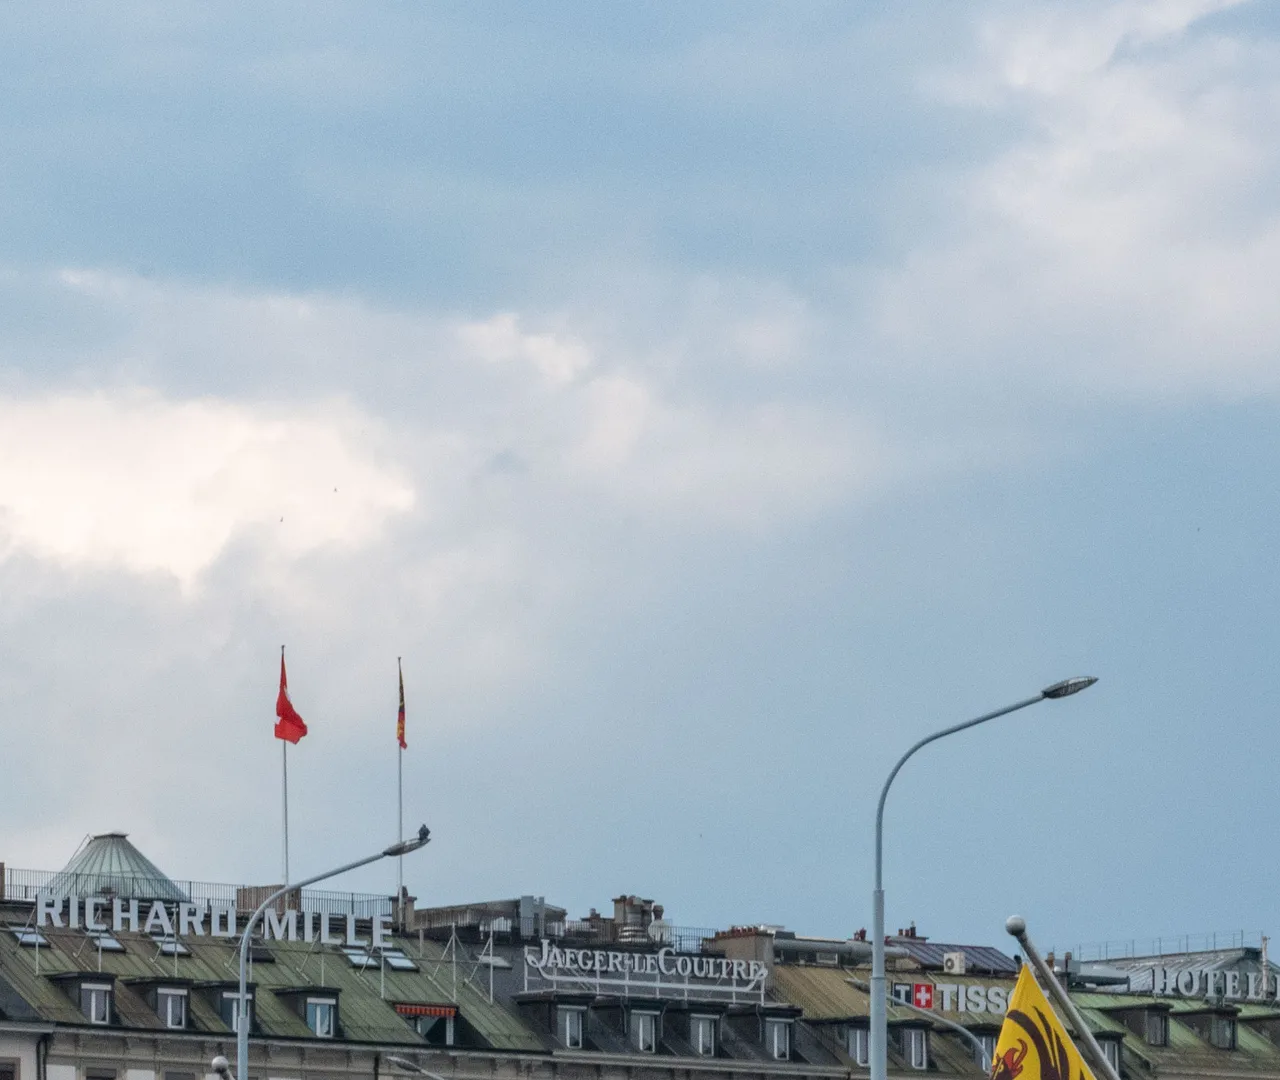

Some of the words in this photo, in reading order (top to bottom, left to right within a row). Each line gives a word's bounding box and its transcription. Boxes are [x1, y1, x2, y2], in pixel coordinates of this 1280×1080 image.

[36, 895, 237, 938] RICHARD
[263, 908, 394, 948] MILLE
[936, 984, 1049, 1014] TISS
